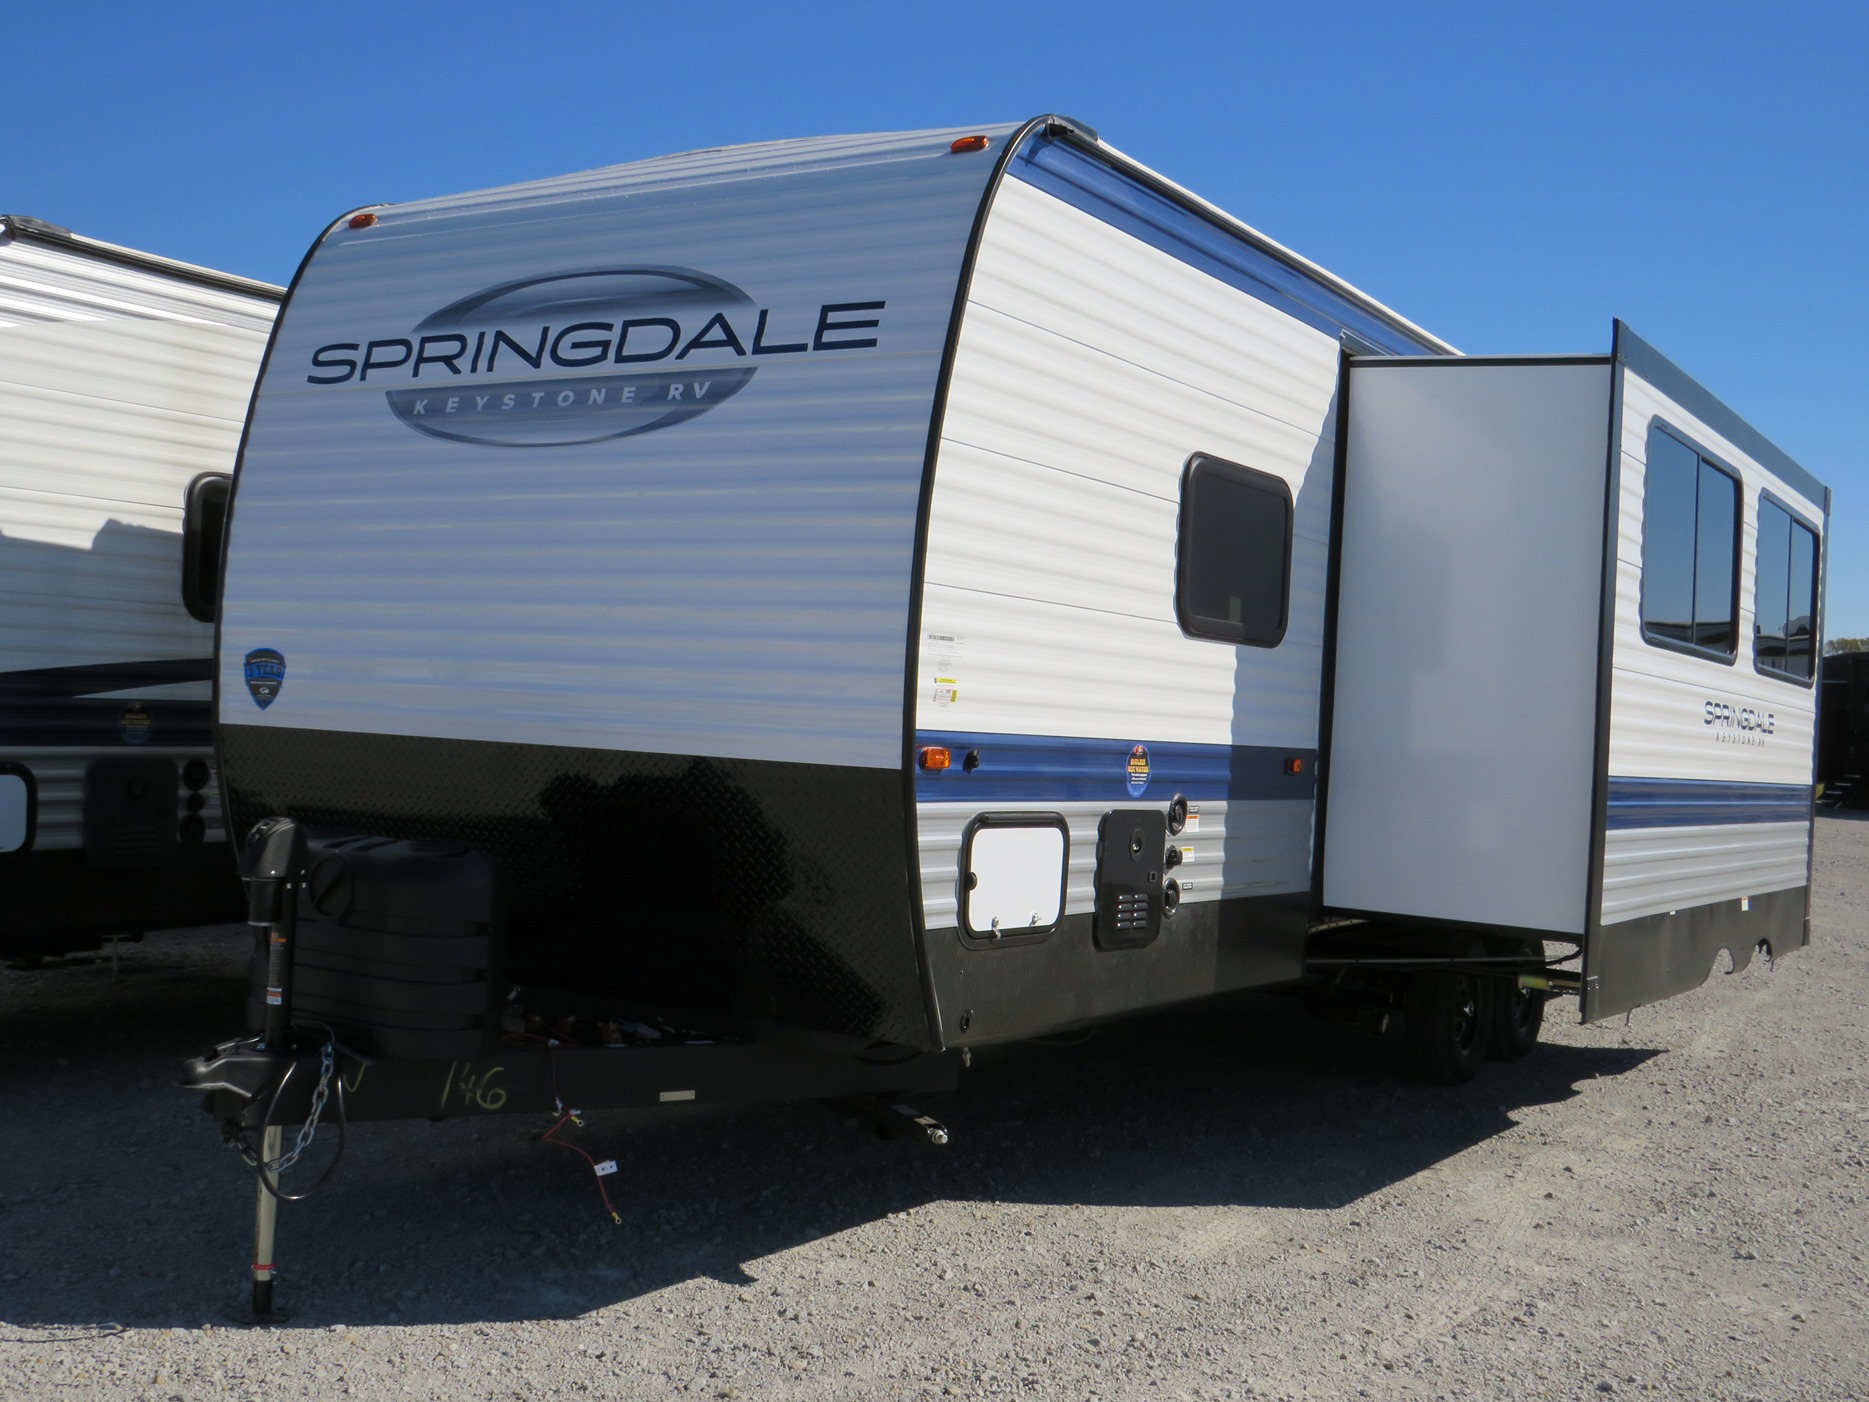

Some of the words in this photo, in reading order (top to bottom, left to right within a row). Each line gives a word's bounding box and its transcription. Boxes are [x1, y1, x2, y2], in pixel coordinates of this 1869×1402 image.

[306, 300, 886, 384] SPRINGDALE
[413, 386, 636, 415] KEYSTONE
[667, 381, 711, 401] RV
[1704, 701, 1775, 734] SPRINGDALE
